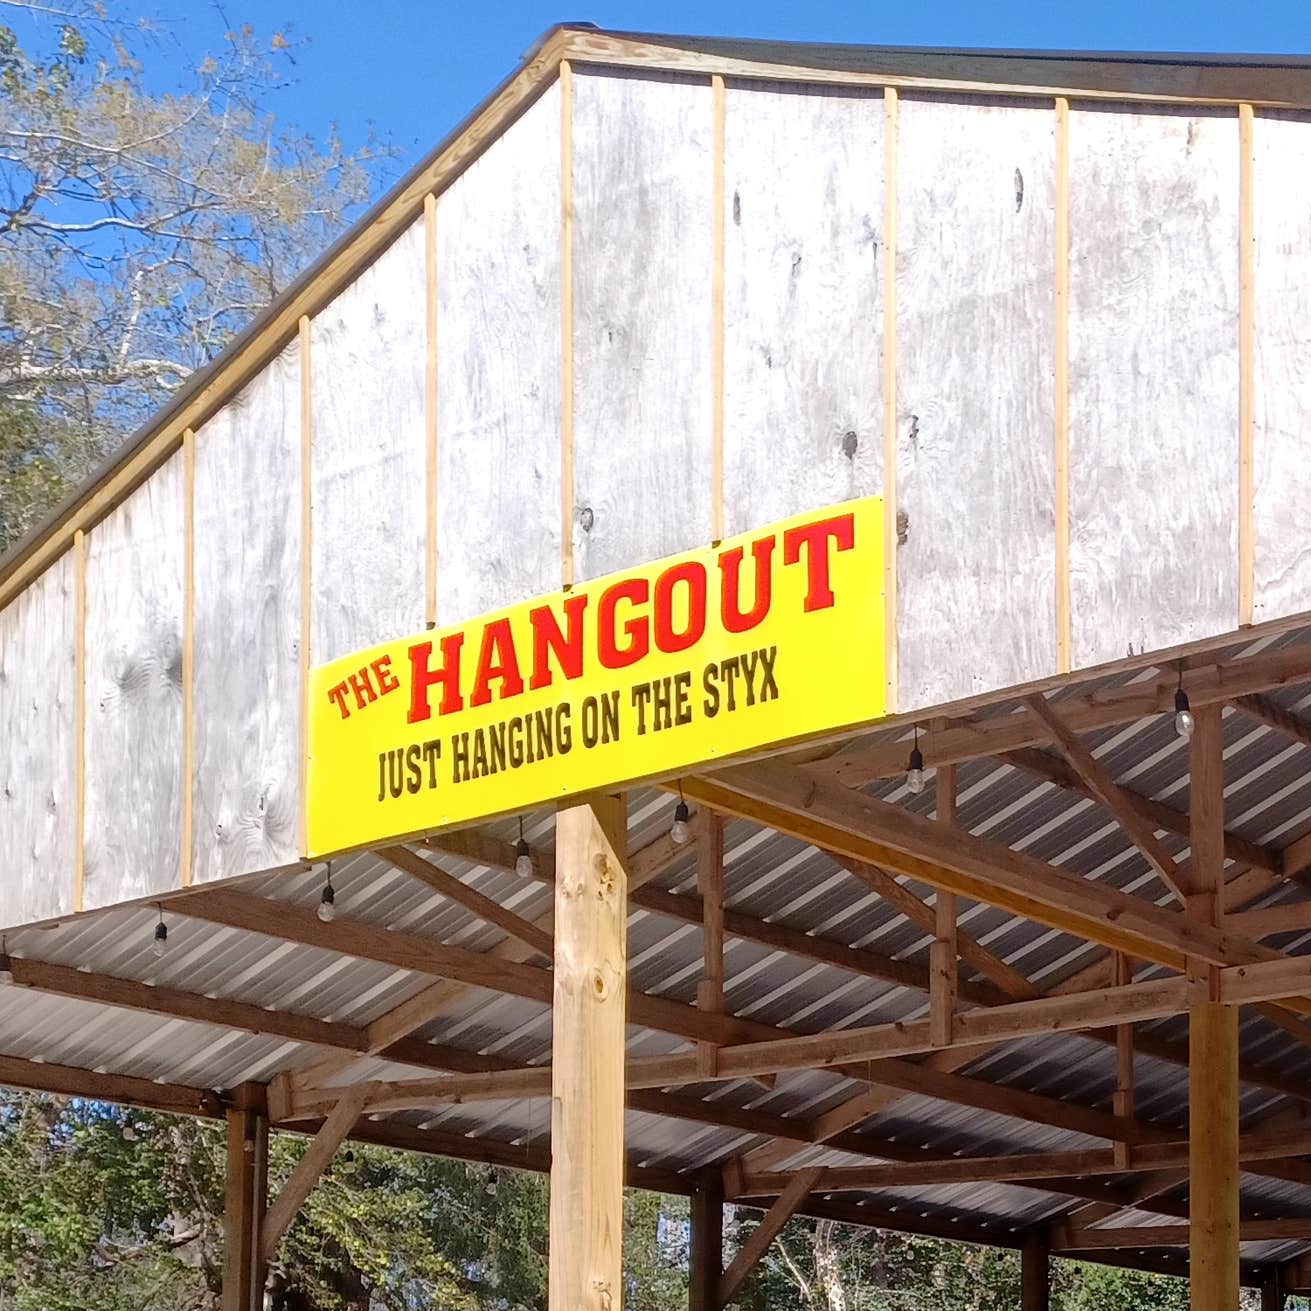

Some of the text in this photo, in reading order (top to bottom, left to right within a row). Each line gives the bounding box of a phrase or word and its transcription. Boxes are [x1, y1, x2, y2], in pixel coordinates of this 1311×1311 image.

[328, 513, 855, 724] THE HANGOUT
[377, 645, 779, 802] JUST HANGING ON THE STYX
